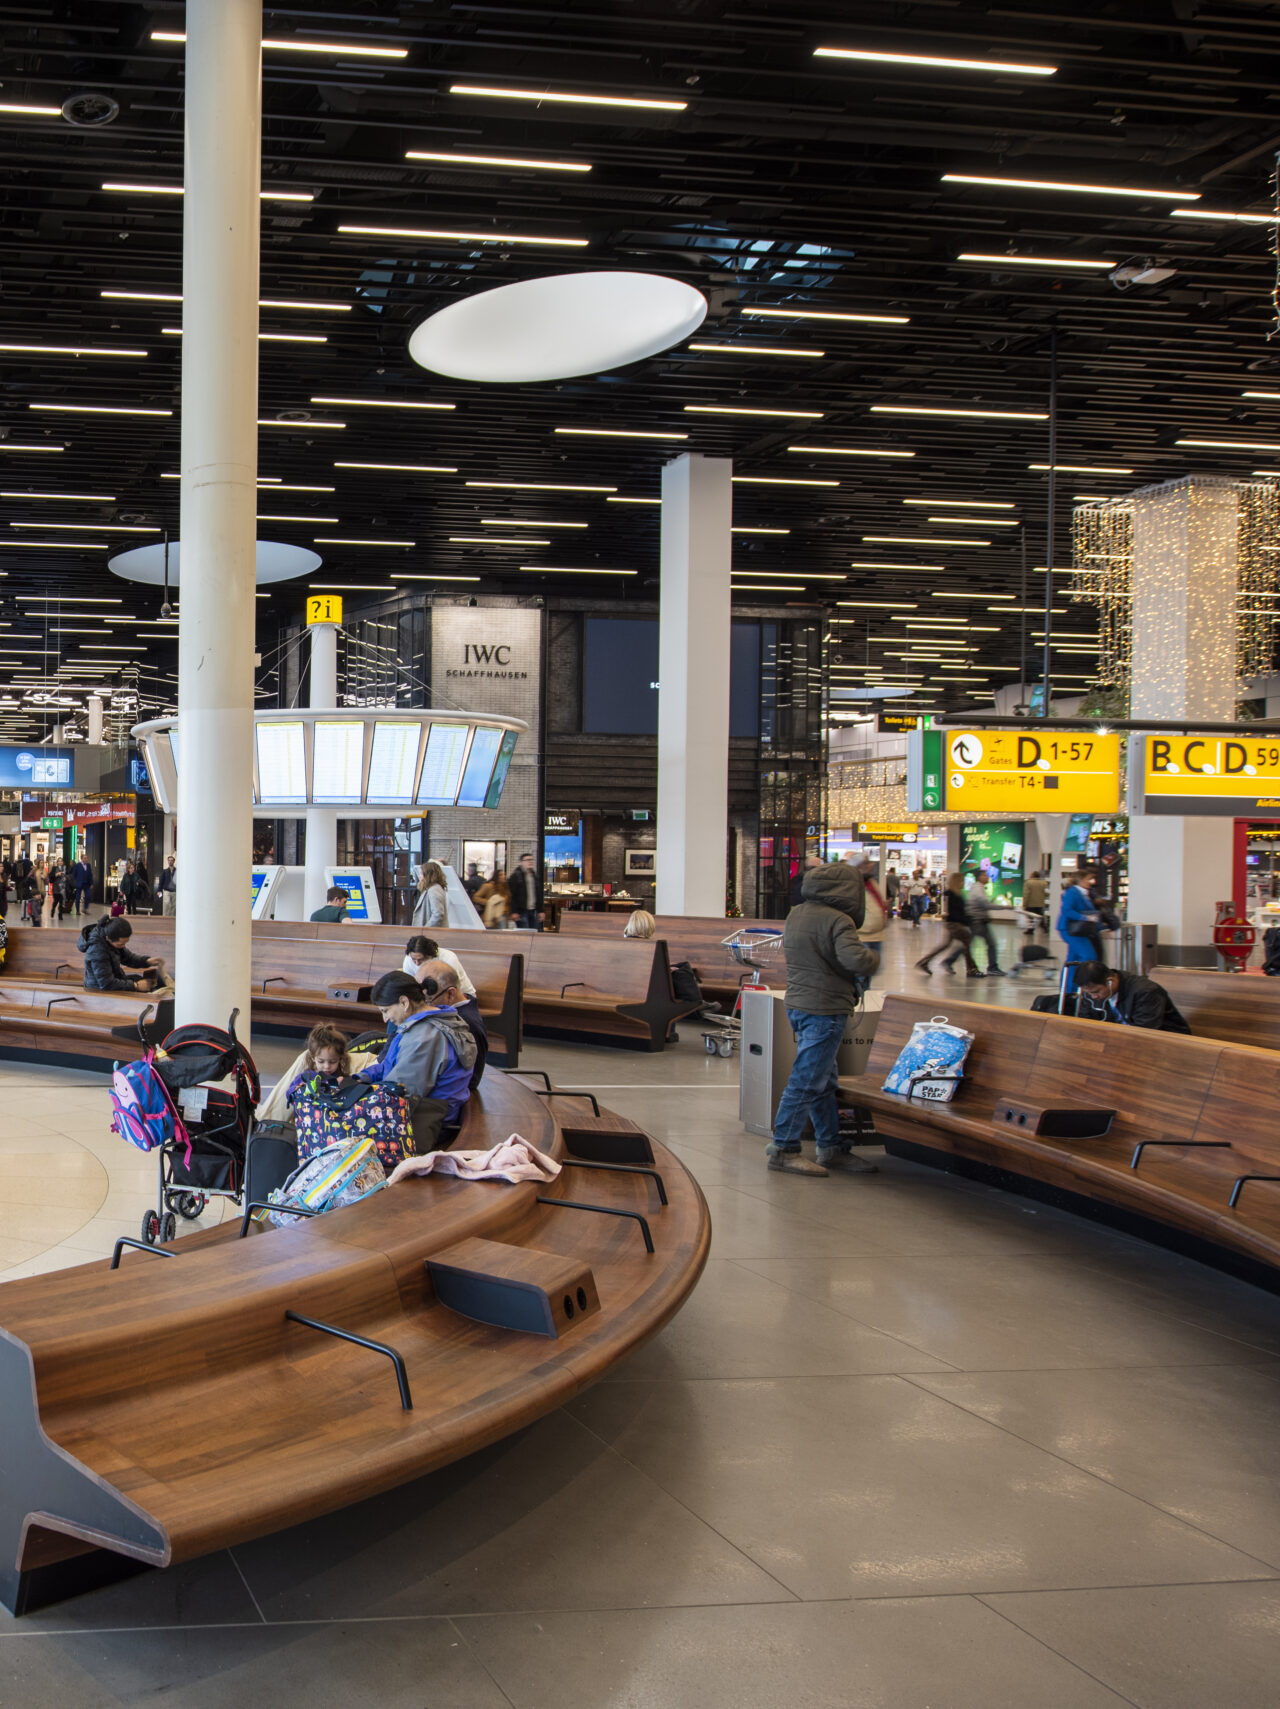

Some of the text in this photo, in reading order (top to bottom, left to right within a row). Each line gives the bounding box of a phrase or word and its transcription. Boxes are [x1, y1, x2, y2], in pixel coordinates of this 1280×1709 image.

[464, 644, 511, 666] IWC
[446, 669, 528, 679] SCHAFFHAUSEN
[989, 736, 1094, 768] Gates D 1-57
[1152, 740, 1171, 772] B
[1184, 741, 1205, 773] C
[1225, 742, 1247, 773] D
[982, 777, 1016, 786] Transfer
[548, 816, 567, 826] IWC
[855, 1037, 864, 1045] to
